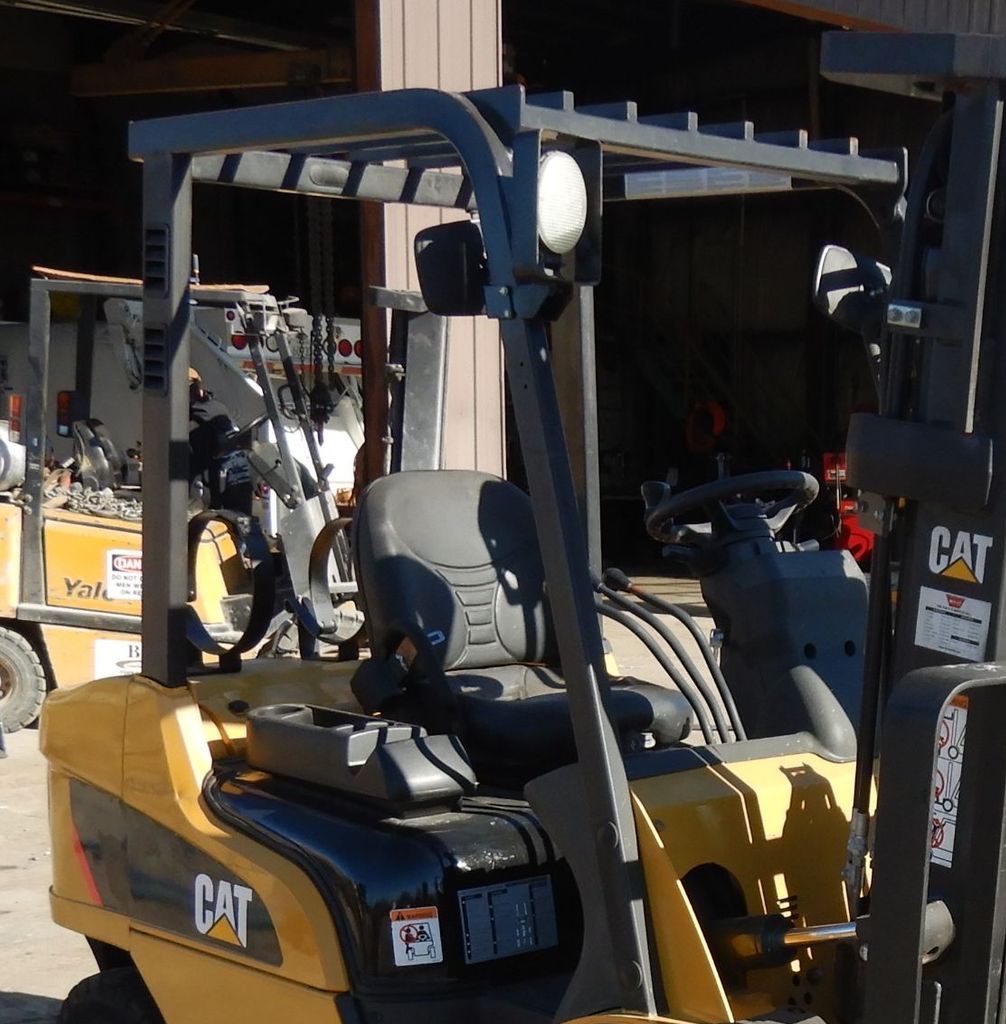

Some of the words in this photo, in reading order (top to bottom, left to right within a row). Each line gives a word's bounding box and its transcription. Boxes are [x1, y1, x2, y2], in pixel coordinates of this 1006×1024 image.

[118, 558, 142, 570] DAN
[928, 525, 994, 584] CAT
[195, 873, 253, 948] CAT
